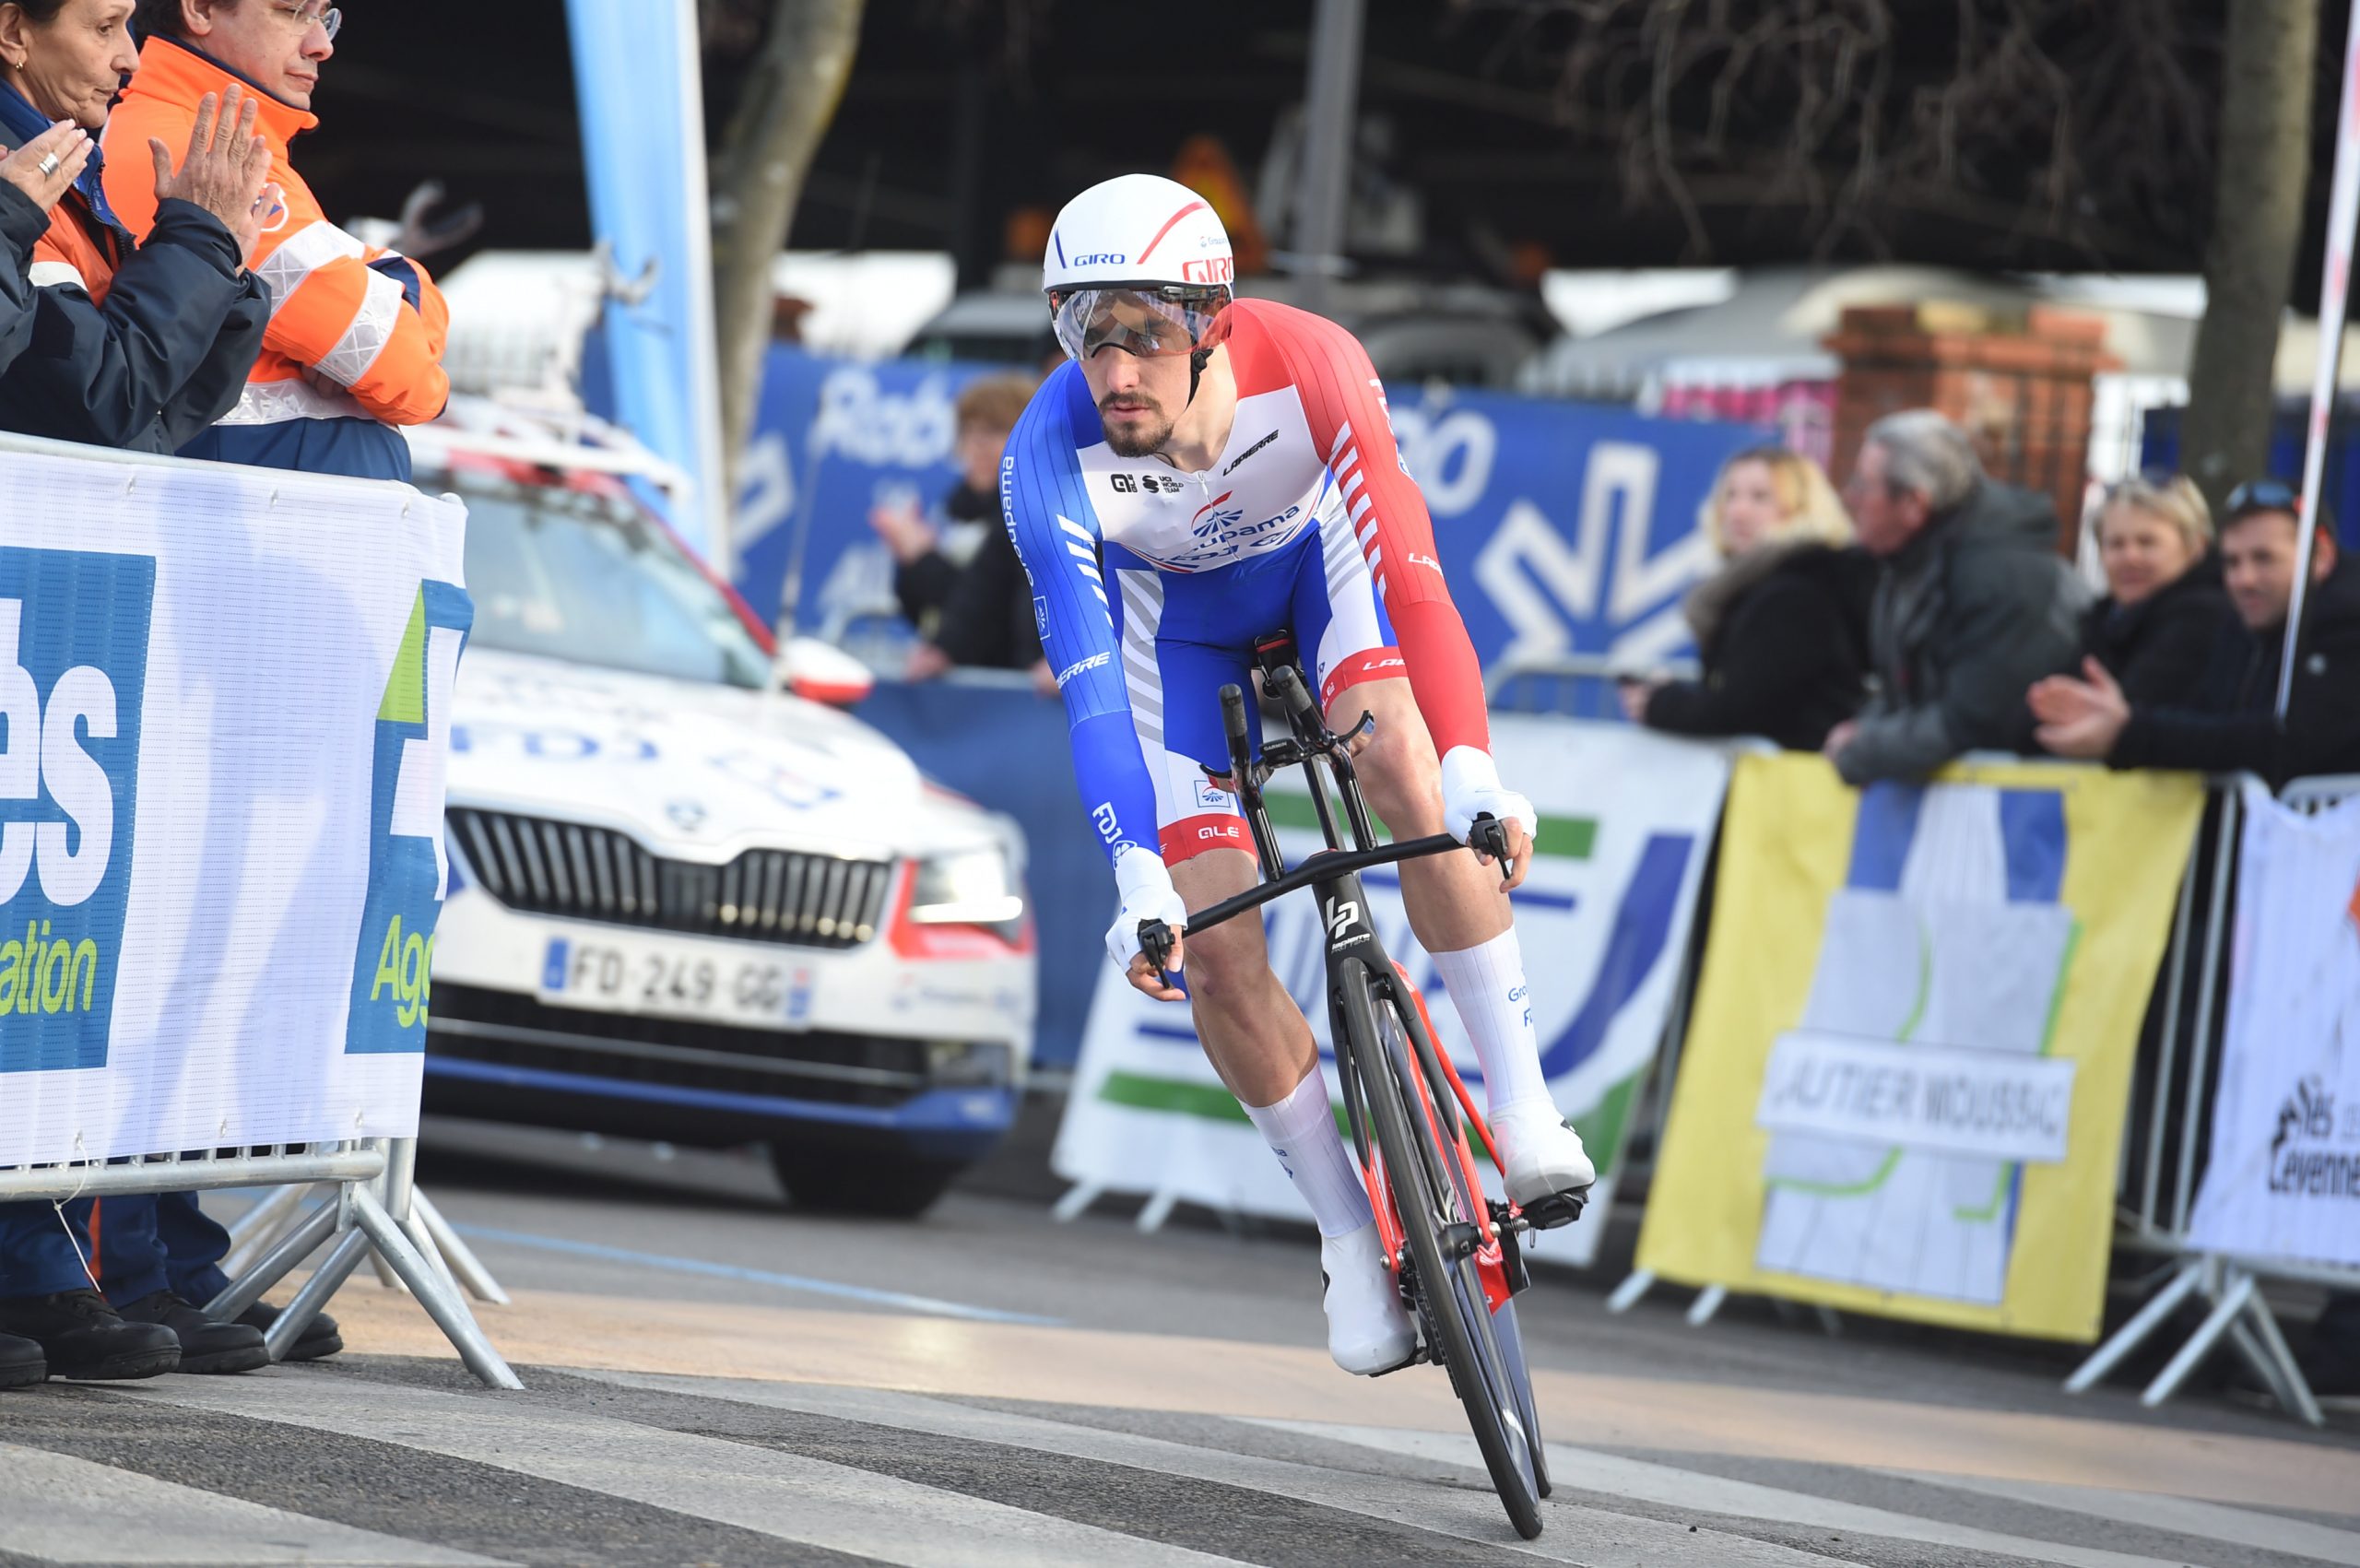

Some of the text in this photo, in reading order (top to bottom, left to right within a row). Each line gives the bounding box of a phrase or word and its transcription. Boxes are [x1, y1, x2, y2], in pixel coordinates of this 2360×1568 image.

[1074, 253, 1126, 266] GIRO
[1222, 429, 1280, 477] LAPIERRE
[1263, 741, 1287, 751] GARMIN
[1092, 801, 1124, 844] FDJ
[0, 919, 98, 1015] ation
